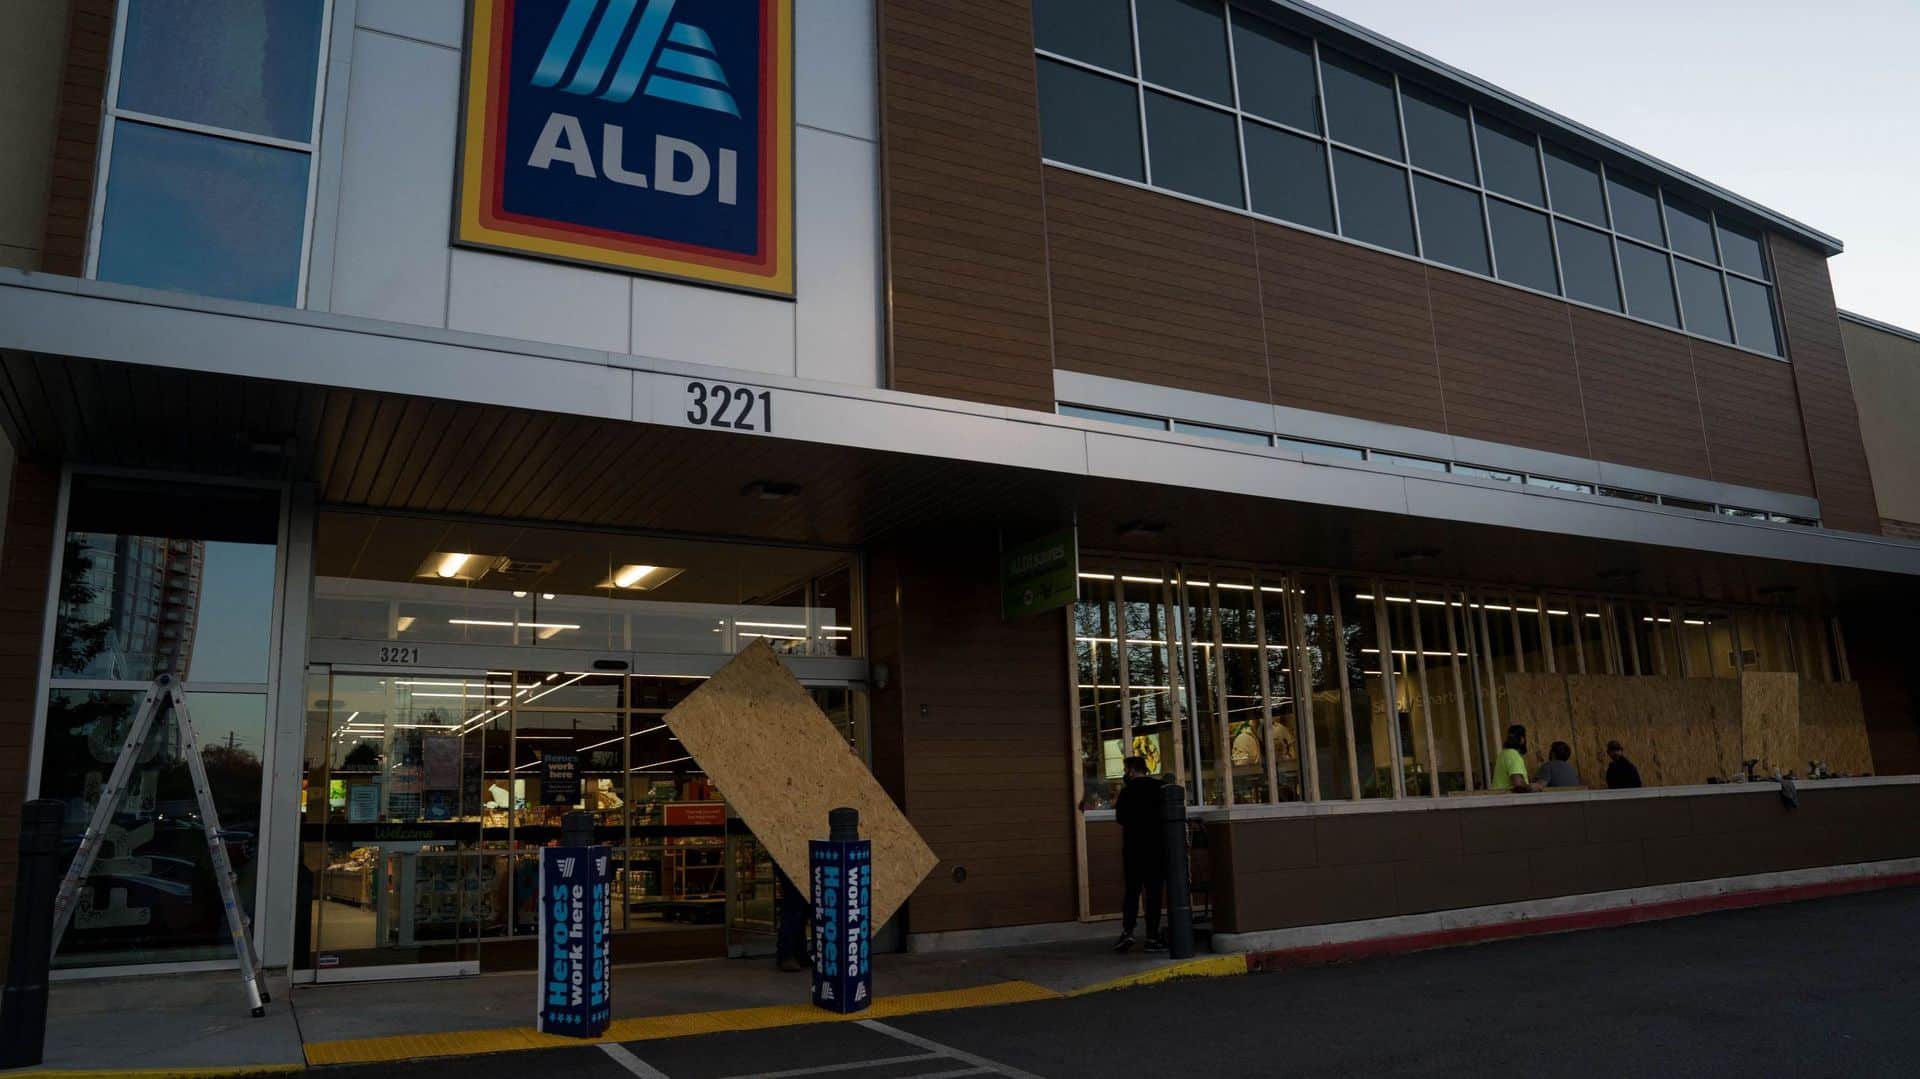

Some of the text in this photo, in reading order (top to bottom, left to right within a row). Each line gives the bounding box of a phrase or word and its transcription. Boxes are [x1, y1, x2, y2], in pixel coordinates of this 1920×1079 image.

[527, 112, 738, 206] ALDI
[687, 381, 772, 433] 3221
[380, 647, 420, 664] 3221
[547, 762, 575, 770] work
[548, 770, 575, 780] here
[549, 883, 569, 1007] Heroes
[569, 884, 584, 1007] work here
[591, 882, 604, 1006] Heroes
[602, 882, 610, 1001] work here
[814, 865, 824, 975] work here
[823, 865, 841, 977] Heroes
[847, 866, 861, 977] work here
[859, 864, 872, 975] Heroes
